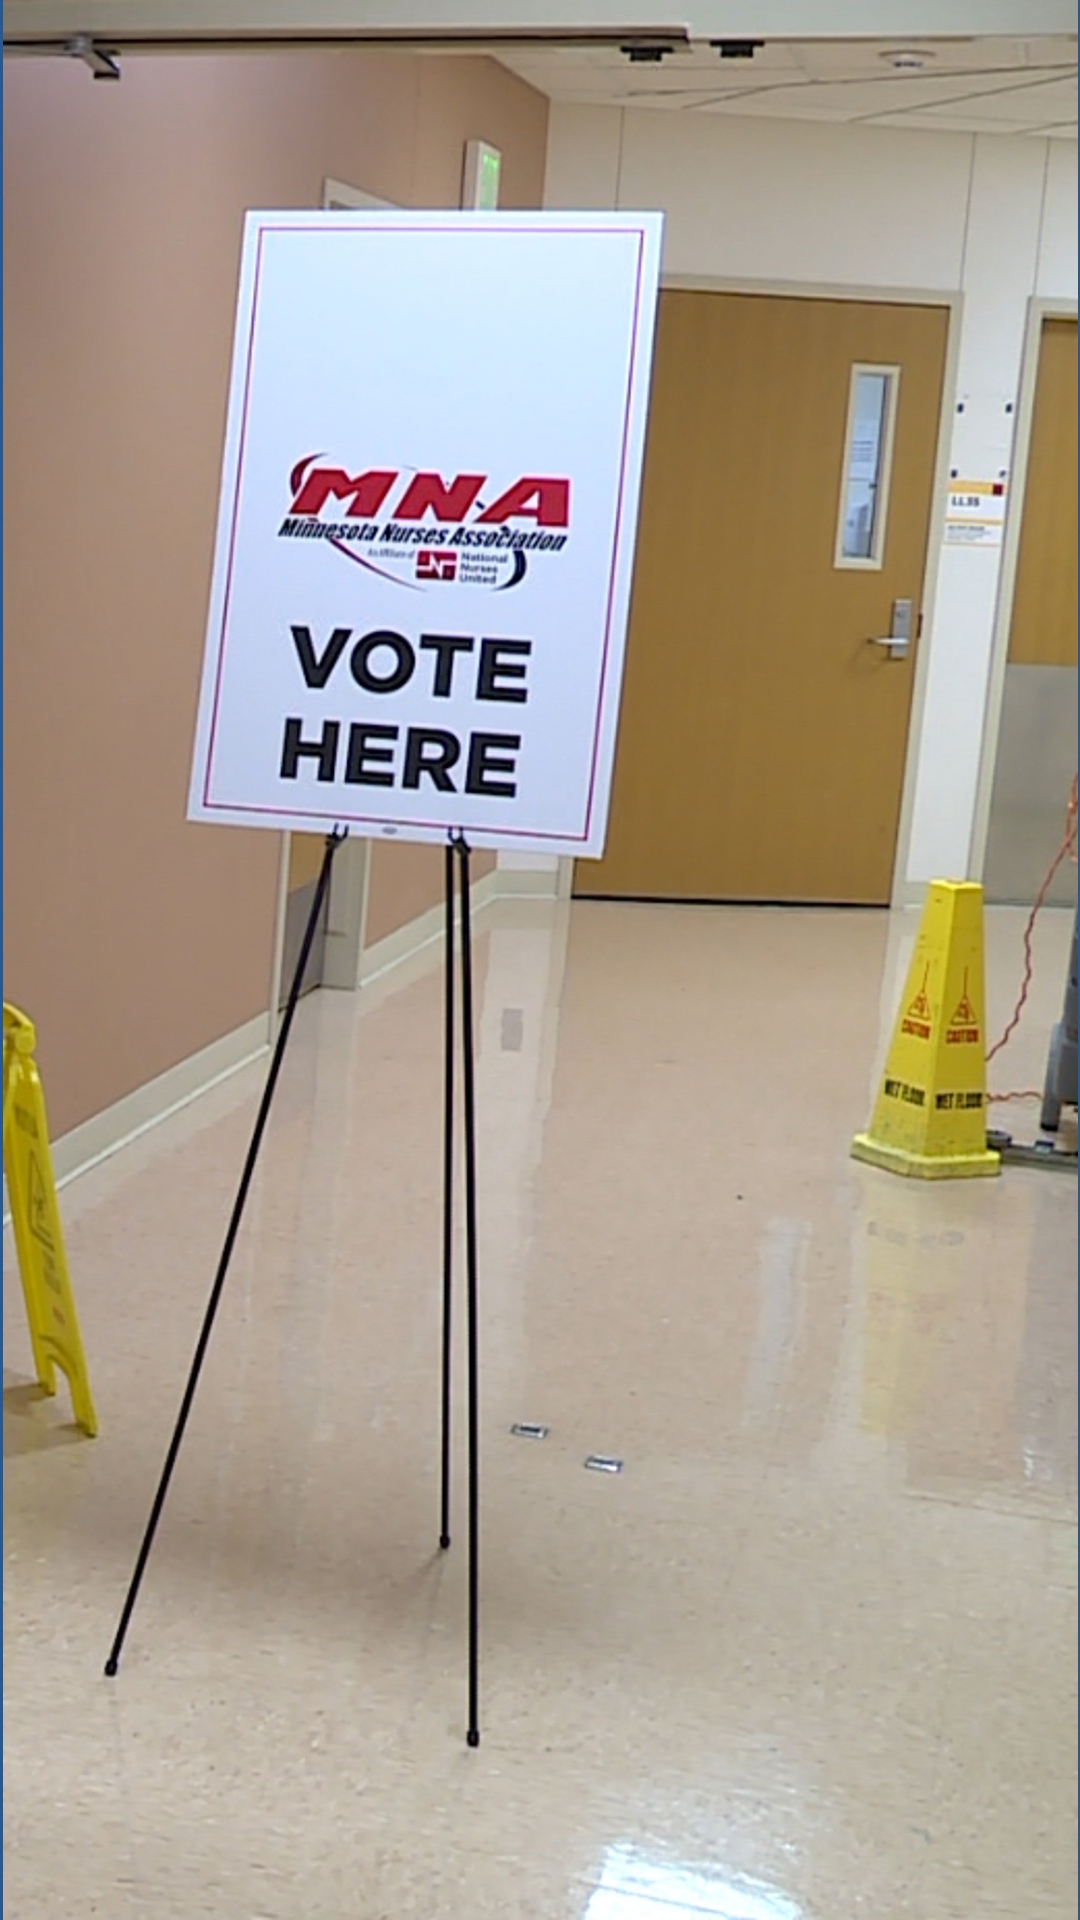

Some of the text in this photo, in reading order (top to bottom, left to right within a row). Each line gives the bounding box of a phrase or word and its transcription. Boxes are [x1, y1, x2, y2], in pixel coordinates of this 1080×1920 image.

[288, 468, 569, 527] MNA
[278, 517, 567, 551] Minnesota Nurses Association
[460, 562, 498, 574] Nurses
[461, 552, 508, 564] National
[459, 573, 497, 585] United
[290, 625, 532, 704] VOTE
[279, 717, 521, 798] HERE
